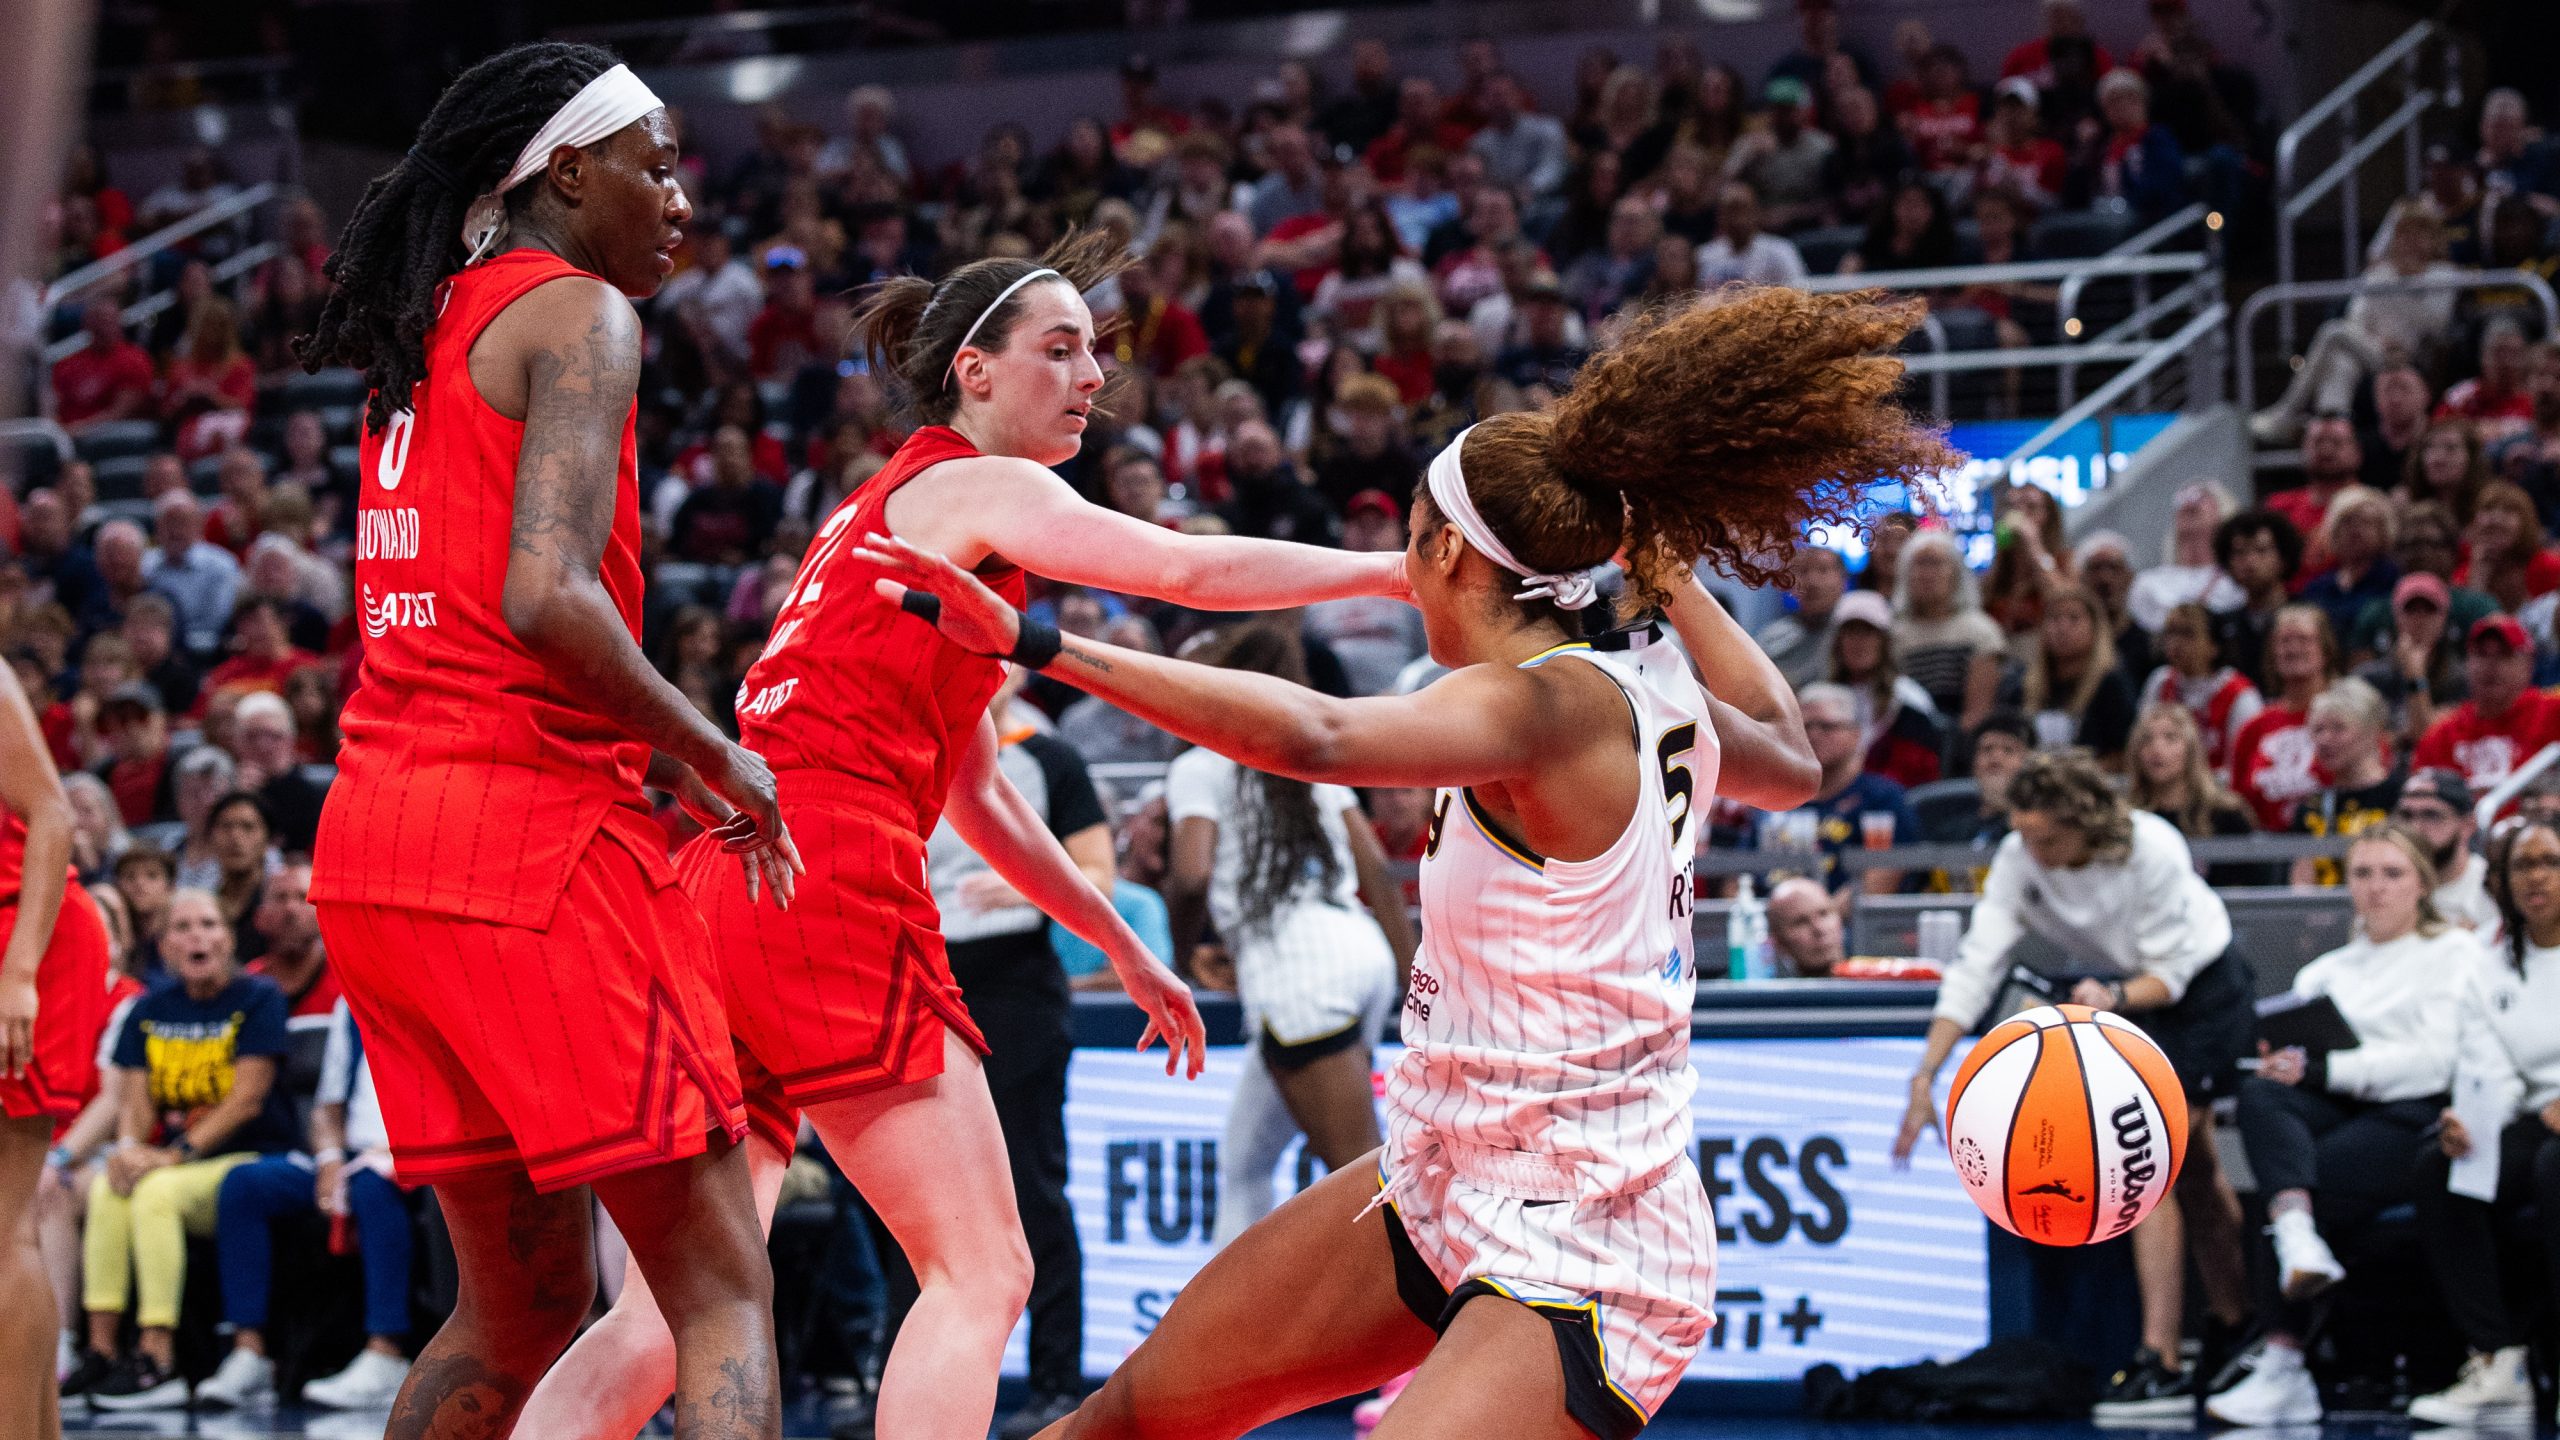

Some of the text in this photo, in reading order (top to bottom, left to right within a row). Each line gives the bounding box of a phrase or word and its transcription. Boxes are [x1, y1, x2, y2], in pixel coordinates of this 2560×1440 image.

[357, 507, 420, 561] HOWARD
[381, 591, 438, 628] AT&T
[741, 677, 799, 715] AT&T
[1656, 718, 1697, 849] 5
[1669, 858, 1694, 921] RE
[1403, 989, 1431, 1022] cine
[1699, 1136, 1850, 1246] ESS
[2108, 1093, 2157, 1237] Wilson
